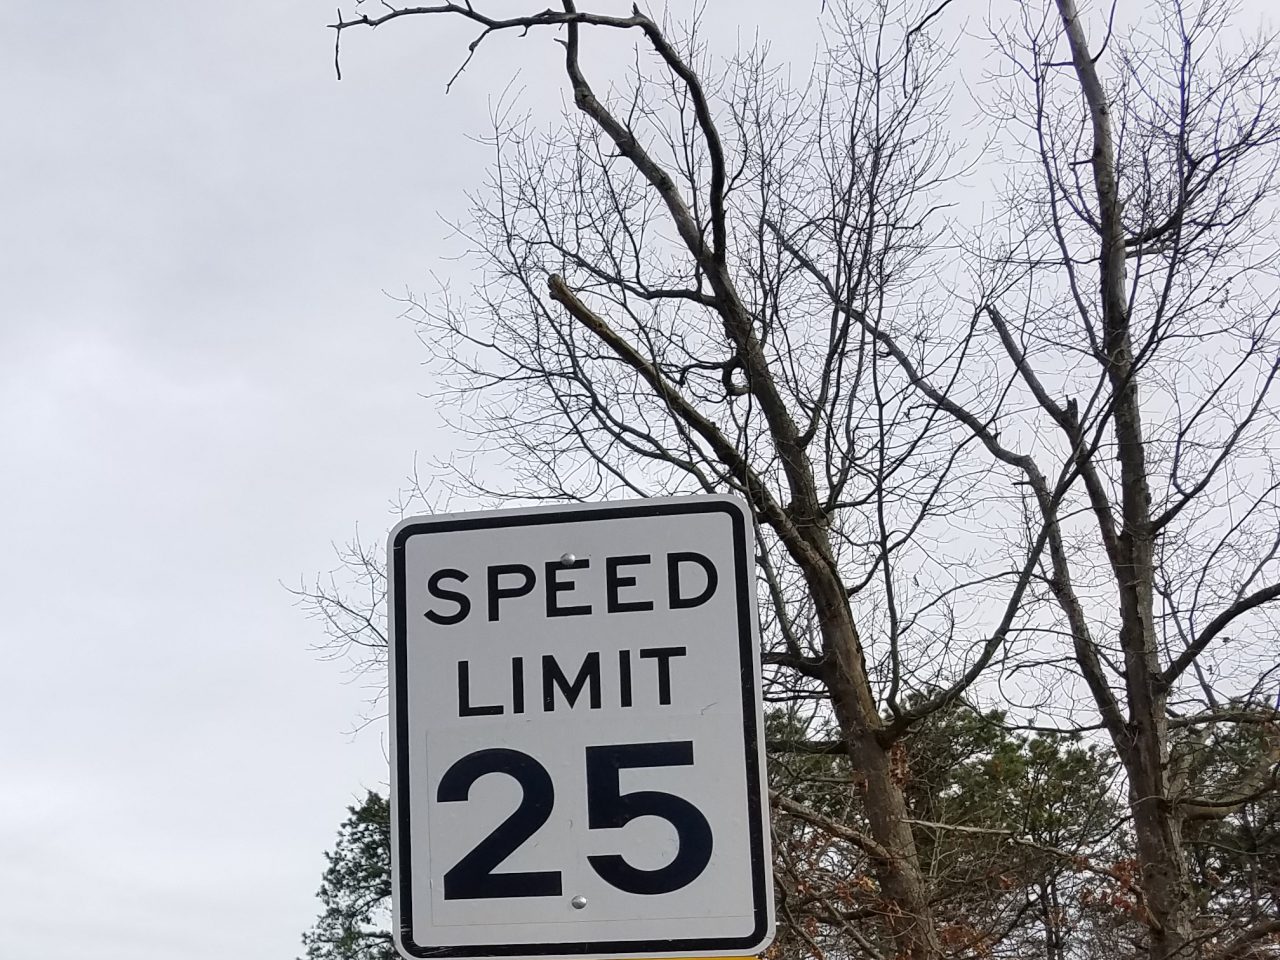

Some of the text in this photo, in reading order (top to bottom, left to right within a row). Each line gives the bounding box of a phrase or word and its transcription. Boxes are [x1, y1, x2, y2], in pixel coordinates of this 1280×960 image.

[423, 551, 719, 626] SPEED
[457, 646, 687, 718] LIMIT
[436, 740, 714, 901] 25
